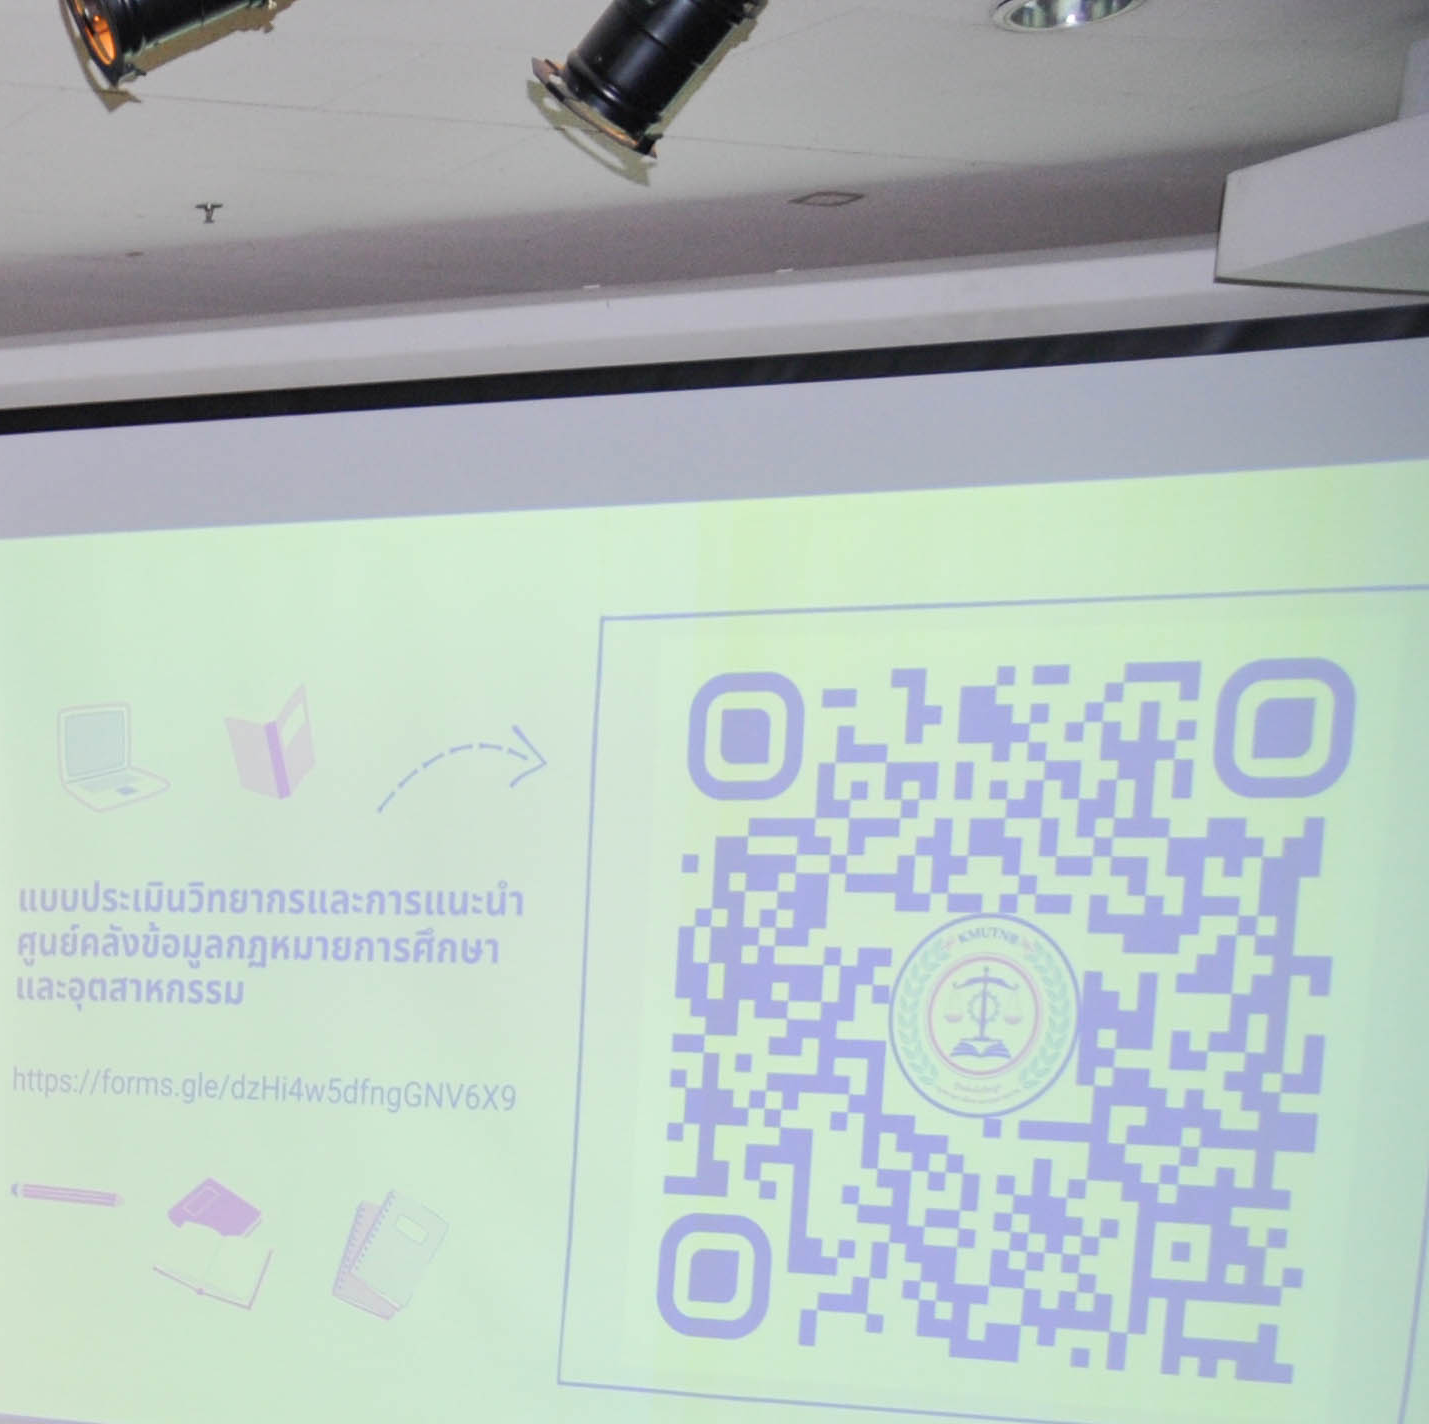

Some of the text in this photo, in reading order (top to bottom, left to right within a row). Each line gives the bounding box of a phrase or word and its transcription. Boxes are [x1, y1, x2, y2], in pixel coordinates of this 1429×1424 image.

[18, 880, 524, 917] แบบประเมินวิทยากรและการแนะนำ
[957, 927, 1020, 945] KMUTNB
[16, 975, 245, 1011] และอุตสาหกรรม
[12, 1066, 517, 1113] https://forms.gle/dzHi4w5dfngGNV6X9
